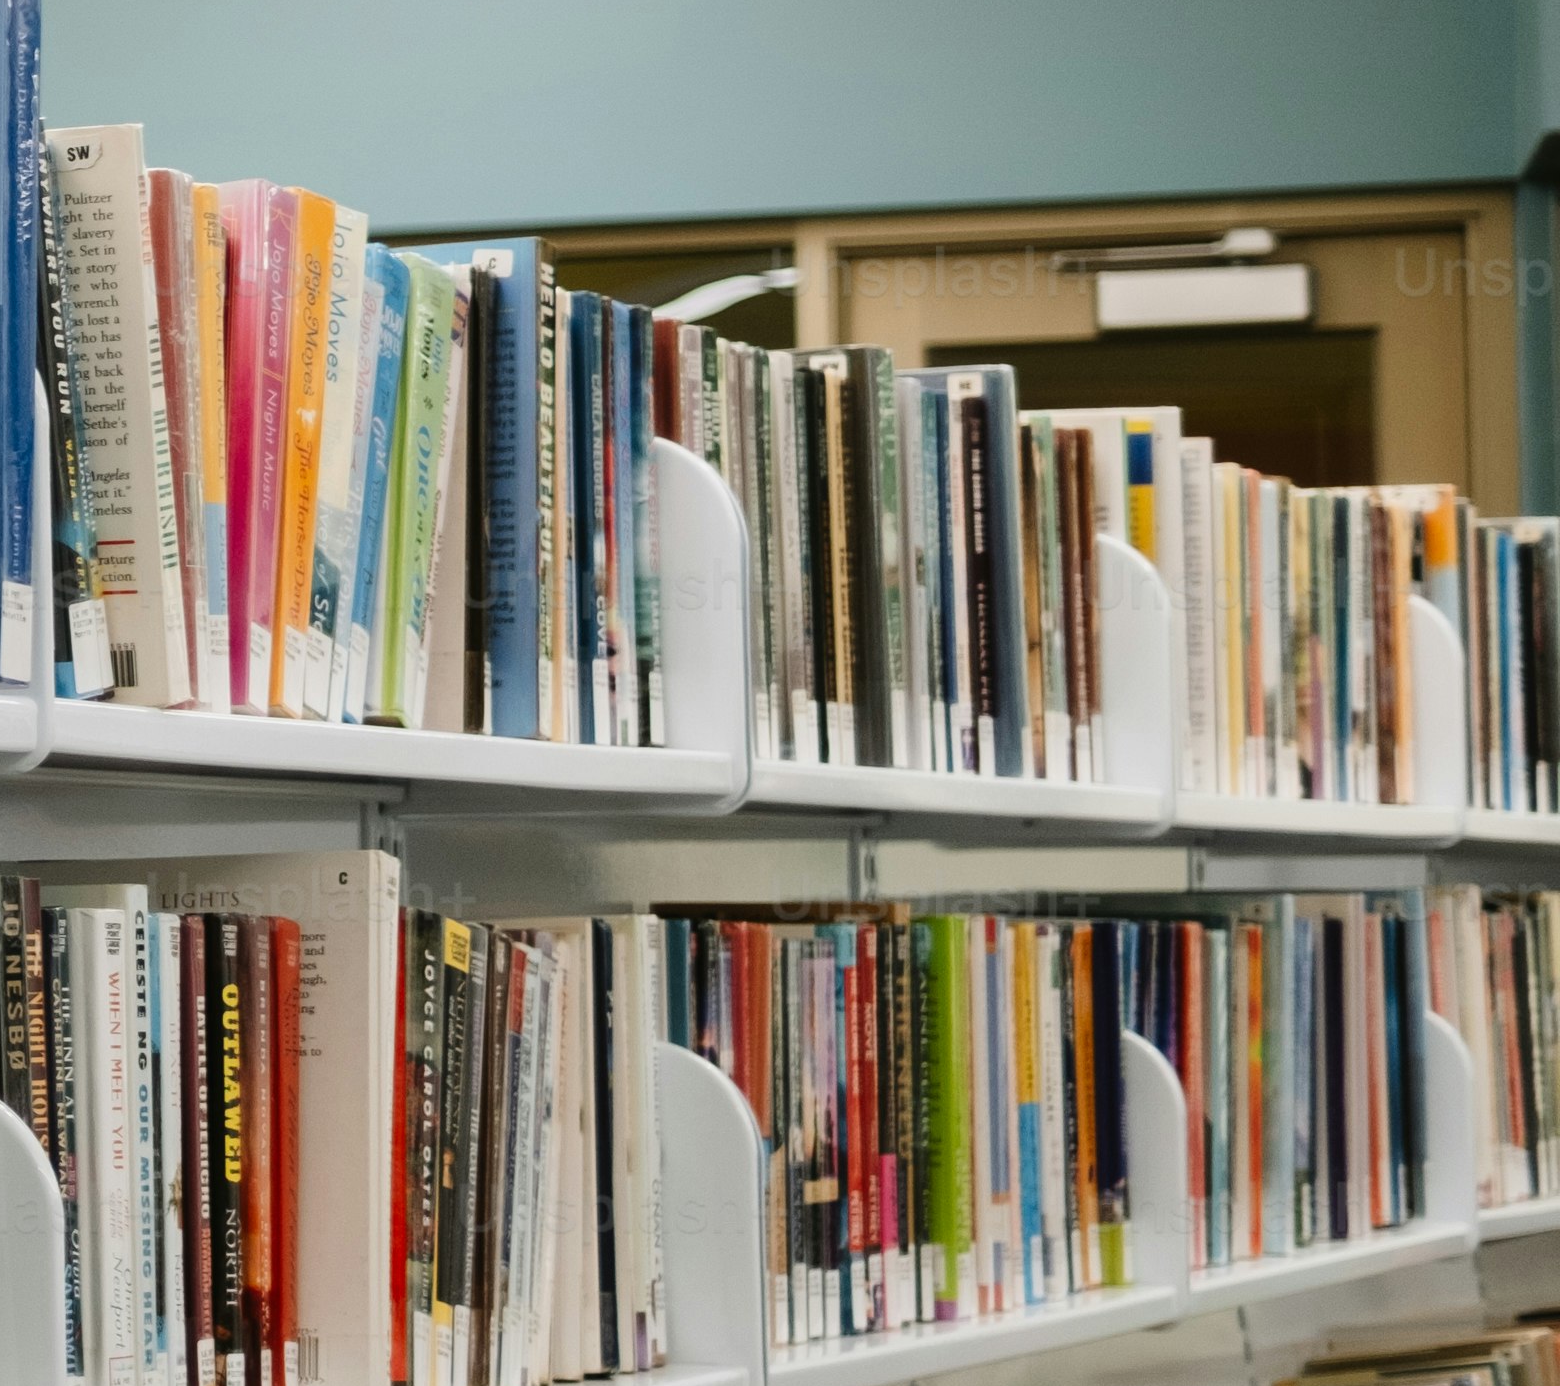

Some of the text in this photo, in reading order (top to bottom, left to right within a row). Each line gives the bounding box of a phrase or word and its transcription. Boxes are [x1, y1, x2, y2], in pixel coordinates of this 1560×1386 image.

[67, 146, 89, 161] SW
[64, 192, 113, 207] Pulitzer
[92, 210, 113, 222] the
[72, 230, 114, 243] slavery
[80, 244, 115, 256] Set in
[87, 262, 117, 277] story
[90, 279, 118, 291] who
[73, 297, 119, 309] wrench
[540, 262, 556, 362] HELLO
[268, 292, 281, 359] Moyes
[101, 331, 121, 342] has
[95, 349, 122, 360] who
[95, 365, 124, 378] back
[84, 398, 126, 412] herself
[160, 890, 241, 910] LIGHTS
[108, 971, 125, 1171] WHEN YOU
[221, 982, 242, 1184] OUTLAWED
[421, 949, 436, 1229] JOYCE CAROL OATES
[225, 1209, 238, 1307] NORTH
